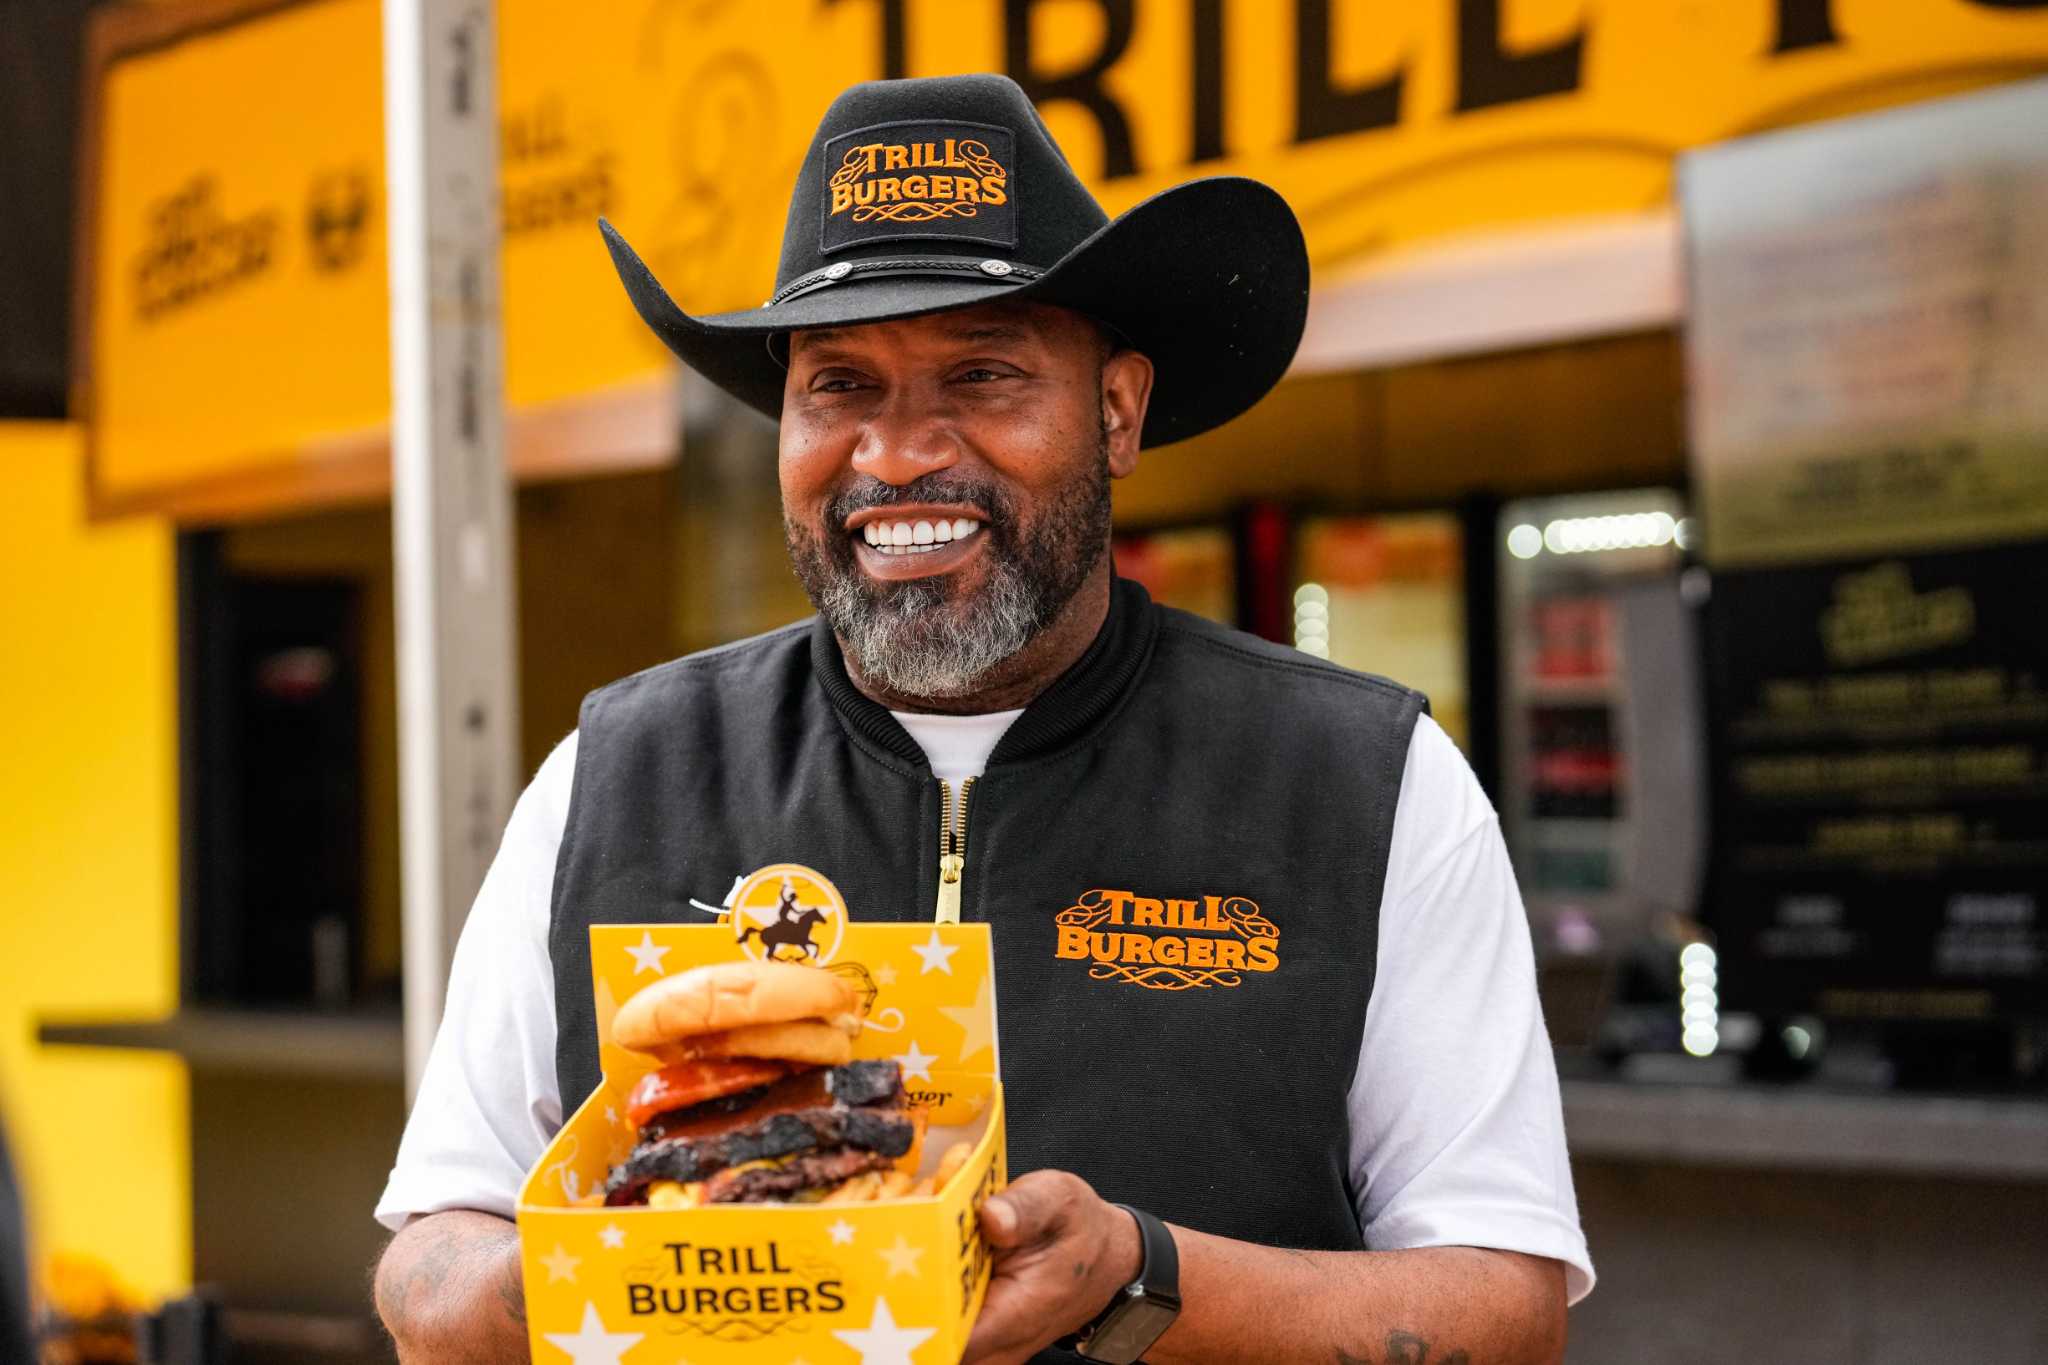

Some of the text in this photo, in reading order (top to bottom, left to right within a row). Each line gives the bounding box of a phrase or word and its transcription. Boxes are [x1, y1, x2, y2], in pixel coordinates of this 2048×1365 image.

[859, 139, 967, 174] TRILL
[830, 175, 1008, 216] BURGERS
[1101, 890, 1232, 931] TRILL
[1054, 924, 1280, 973] BURGERS
[904, 1091, 953, 1111] ger
[663, 1241, 792, 1276] TRILL
[628, 1280, 846, 1316] BURGERS
